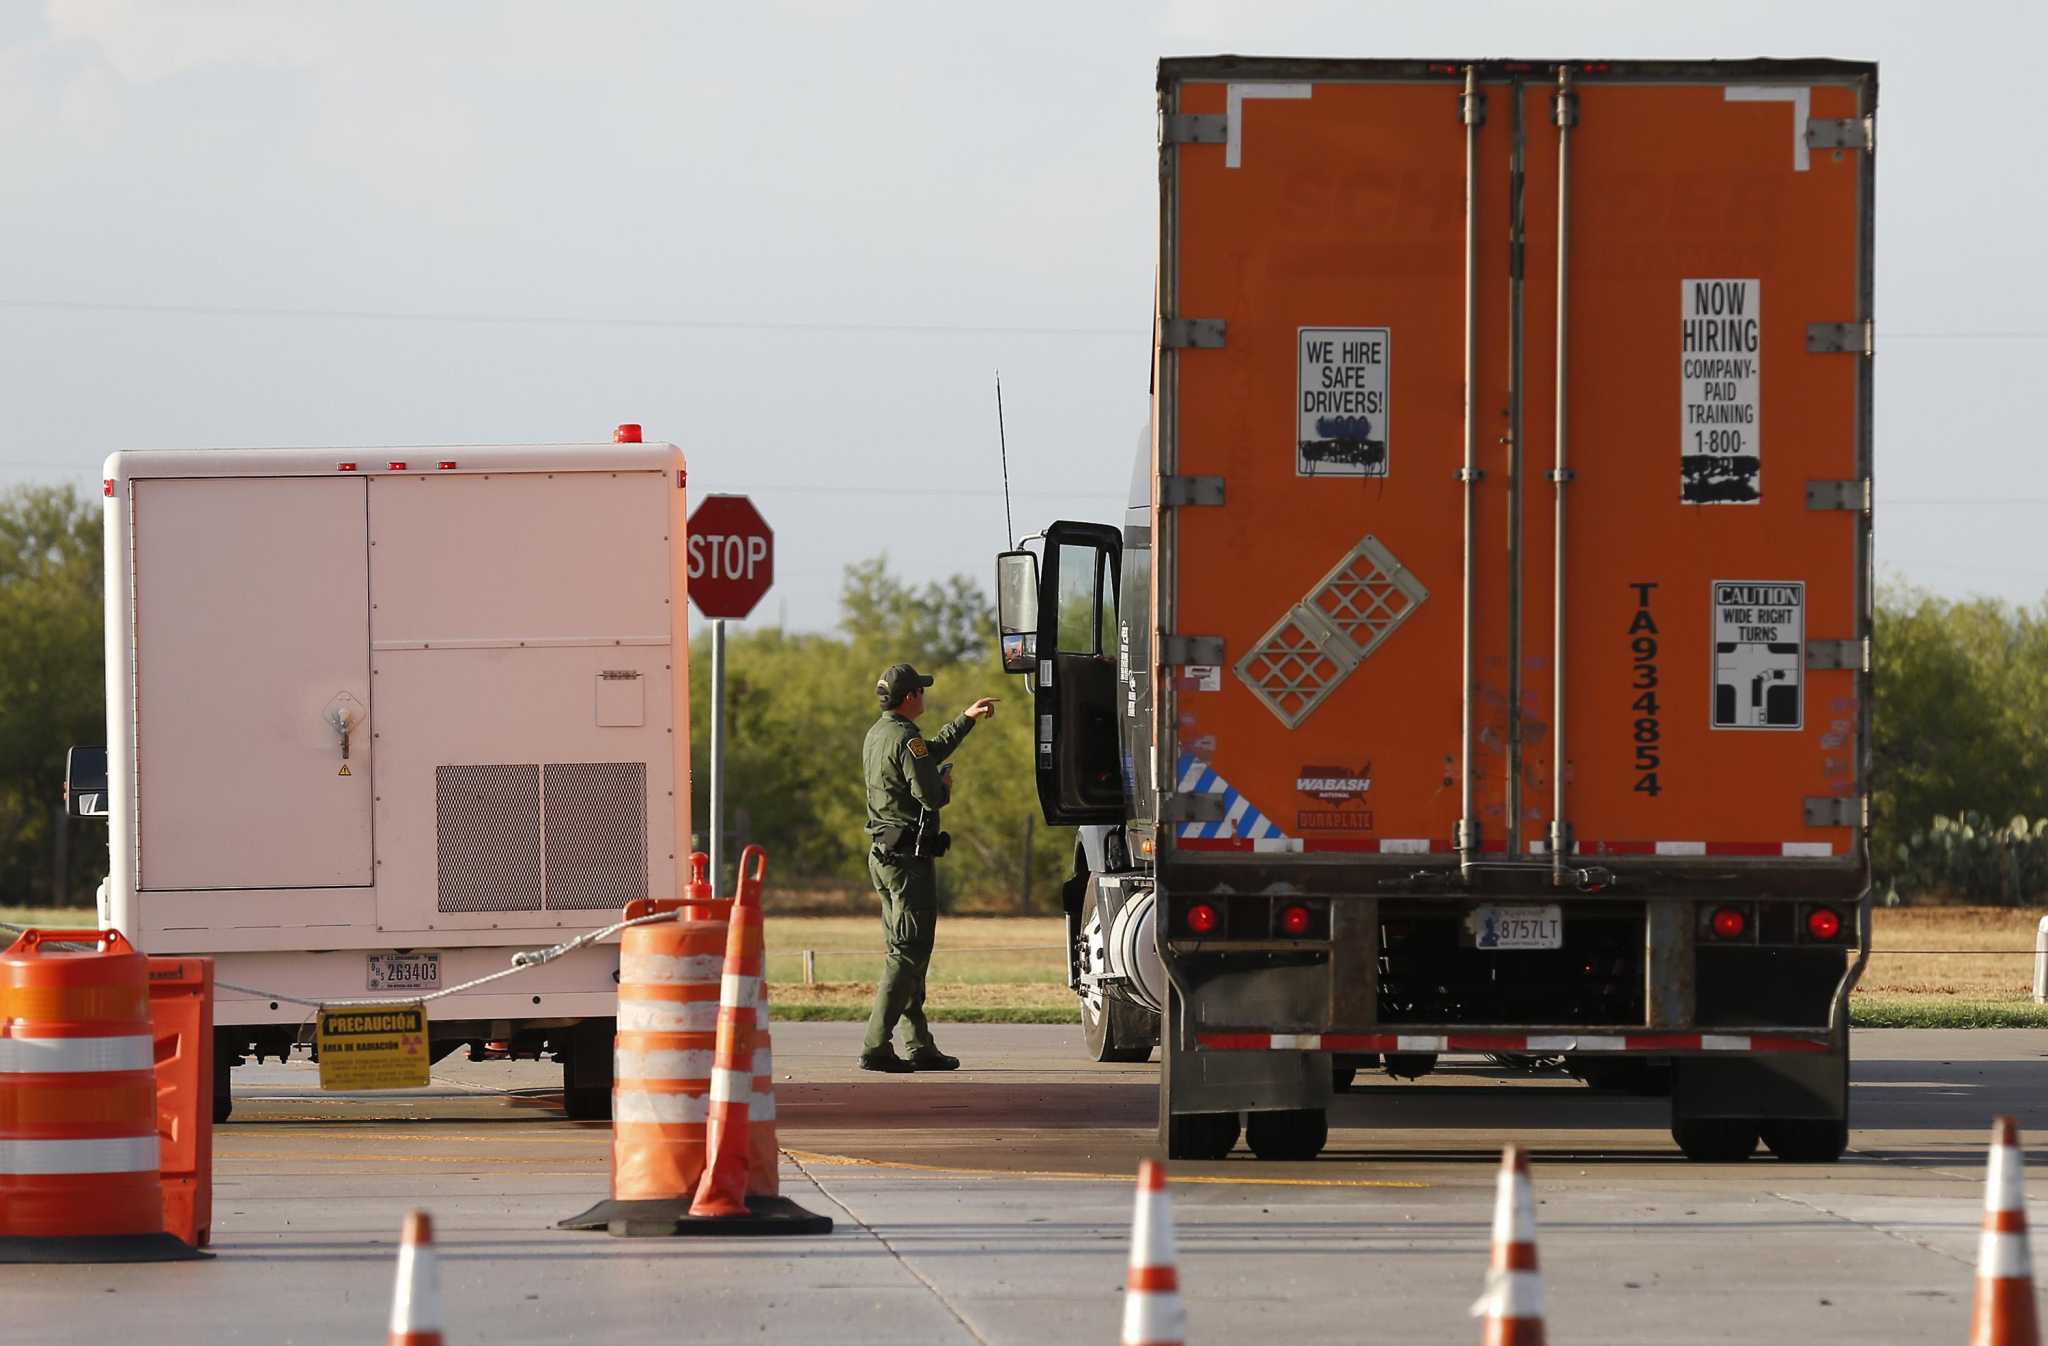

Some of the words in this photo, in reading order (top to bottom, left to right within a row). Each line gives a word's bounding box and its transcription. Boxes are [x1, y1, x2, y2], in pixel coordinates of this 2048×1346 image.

[1695, 282, 1746, 316] NOW
[1683, 319, 1758, 353] HIRING
[1306, 341, 1334, 364] WE
[1342, 341, 1382, 365] HIRE
[1321, 365, 1366, 389] SAFE
[1684, 358, 1757, 380] COMPANY-
[1704, 381, 1737, 401] PAID
[1303, 390, 1383, 414] DRIVERS!
[1687, 403, 1754, 424] TRAINING
[1695, 429, 1747, 454] 1-800-
[687, 534, 767, 580] STOP
[1717, 586, 1799, 605] CAUTION
[1722, 608, 1753, 624] WIDE
[1757, 608, 1793, 624] RIGHT
[1737, 626, 1778, 642] TURNS
[1628, 582, 1662, 797] TA934854
[1296, 778, 1371, 791] WABASH
[1501, 919, 1559, 940] 8757LT
[387, 962, 438, 981] 263403
[328, 1013, 416, 1034] PRECAUCIÓN
